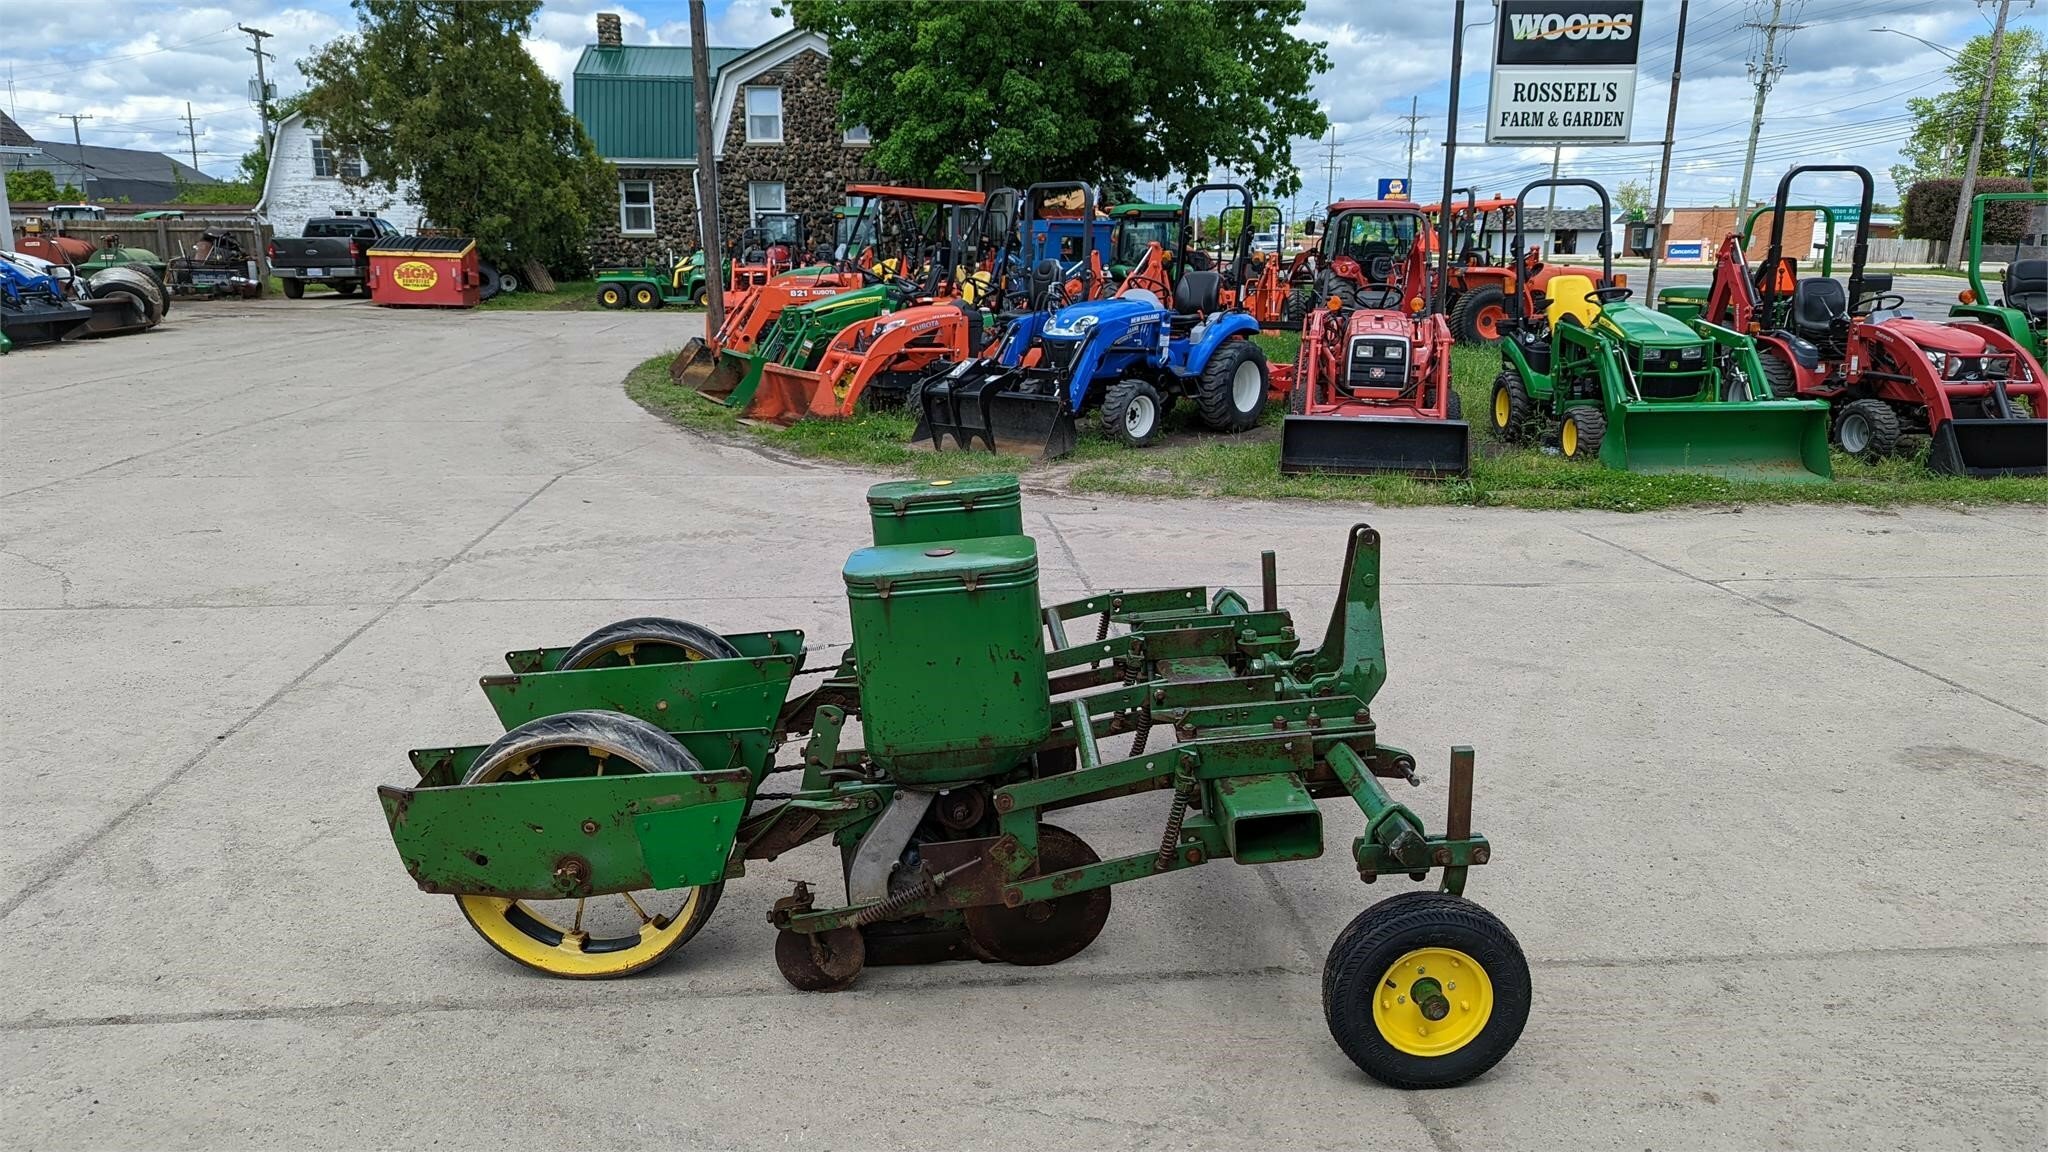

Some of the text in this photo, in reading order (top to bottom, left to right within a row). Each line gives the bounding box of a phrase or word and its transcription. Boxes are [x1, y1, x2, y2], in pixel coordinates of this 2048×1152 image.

[1510, 13, 1633, 41] WOODS
[1512, 82, 1617, 103] ROSSEEL'S
[1500, 111, 1625, 128] FARM & GARDEN
[397, 267, 434, 280] MGM
[911, 320, 940, 333] KUBOTA
